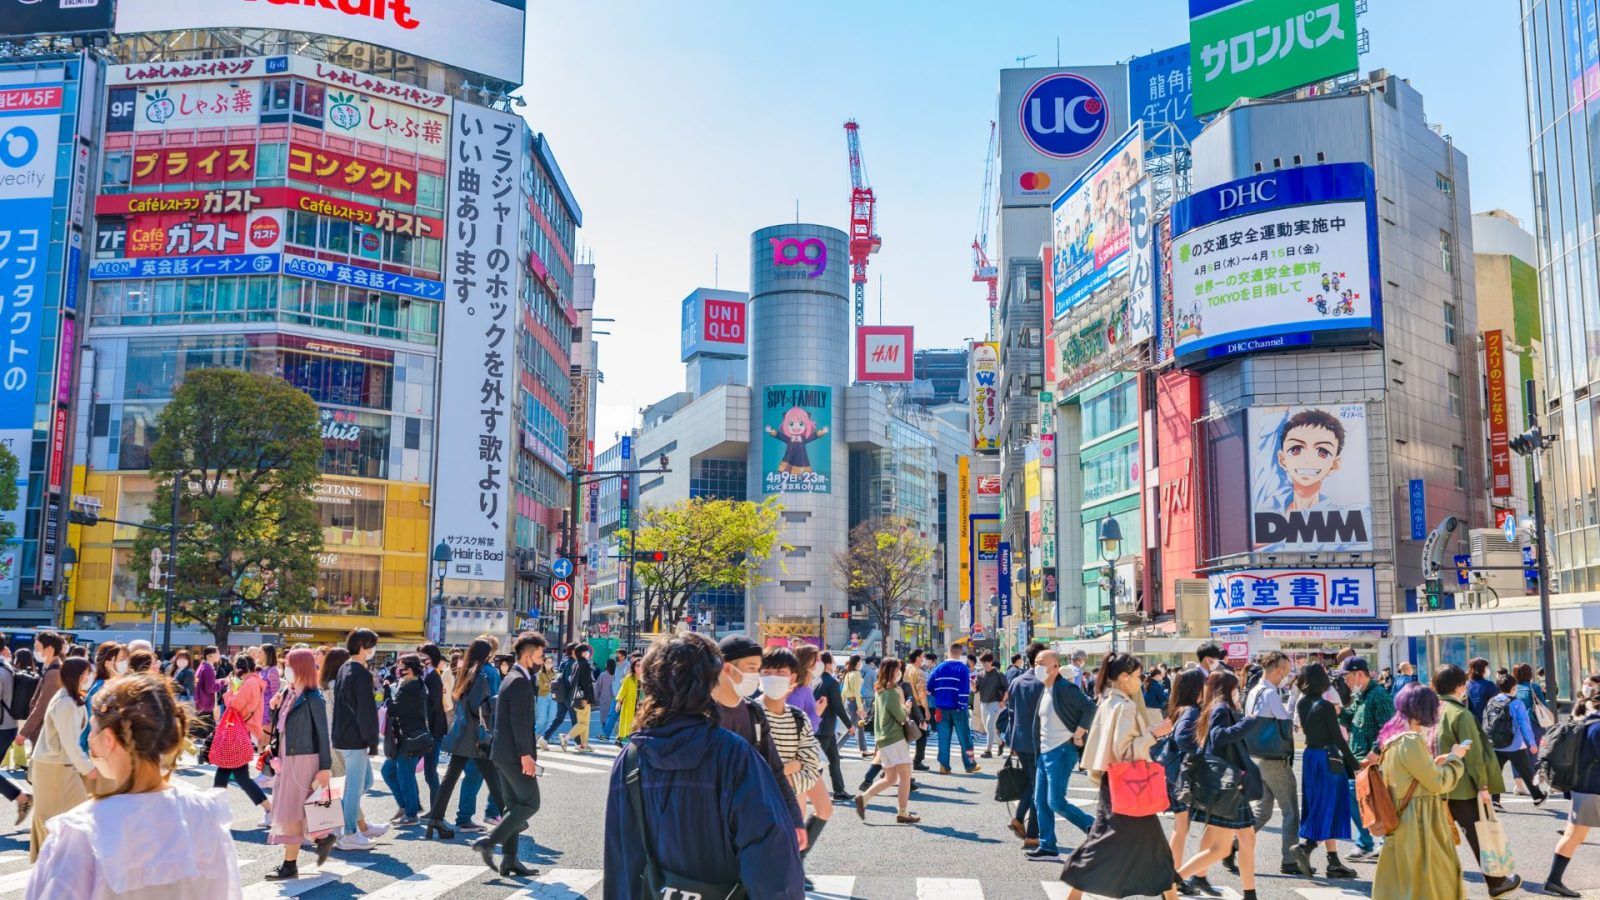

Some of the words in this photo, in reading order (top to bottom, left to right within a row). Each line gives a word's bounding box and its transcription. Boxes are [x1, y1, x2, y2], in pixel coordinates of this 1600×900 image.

[1200, 2, 1345, 82] サロンパス
[125, 60, 254, 81] しゃぶしゃぶバイキング
[316, 63, 445, 107] しゃぶしゃぶバイキング
[111, 102, 134, 118] 9F
[179, 90, 252, 116] しゃぶ葉
[1031, 96, 1100, 134] UC
[368, 106, 443, 144] しゃぶ葉
[136, 150, 251, 178] プライス
[290, 149, 413, 195] コンタクト
[203, 189, 261, 214] ガスト
[1219, 179, 1277, 211] DHC
[375, 209, 432, 238] ガスト
[453, 113, 483, 316] いい曲あります。
[99, 231, 126, 249] 7F
[132, 228, 164, 242] Café
[165, 222, 240, 255] ガスト
[1178, 215, 1346, 264] 春の交通安全運動実施中
[96, 262, 130, 274] AEON
[141, 257, 248, 275] 英会話イーオン
[770, 238, 828, 280] 109
[290, 259, 328, 276] AEON
[337, 265, 442, 297] 英会話イーオン
[1194, 261, 1321, 296] 世界一の交通安全都市
[1208, 280, 1303, 307] TOKYOを目指して
[4, 229, 39, 391] コンタクトの
[479, 122, 516, 530] ブラジャーのホックを外す歌より、
[709, 305, 738, 319] UNI
[708, 323, 741, 339] QLO
[1228, 344, 1246, 353] DHC
[1248, 337, 1284, 350] Channel
[1488, 335, 1504, 425] クスリのことなら
[1492, 432, 1511, 488] 三千里
[447, 534, 495, 546] サブスク解禁
[1254, 510, 1368, 543] DMM
[454, 548, 473, 560] Hair
[475, 549, 483, 560] is
[483, 550, 503, 561] Bad
[1214, 577, 1360, 609] 大盛堂書店
